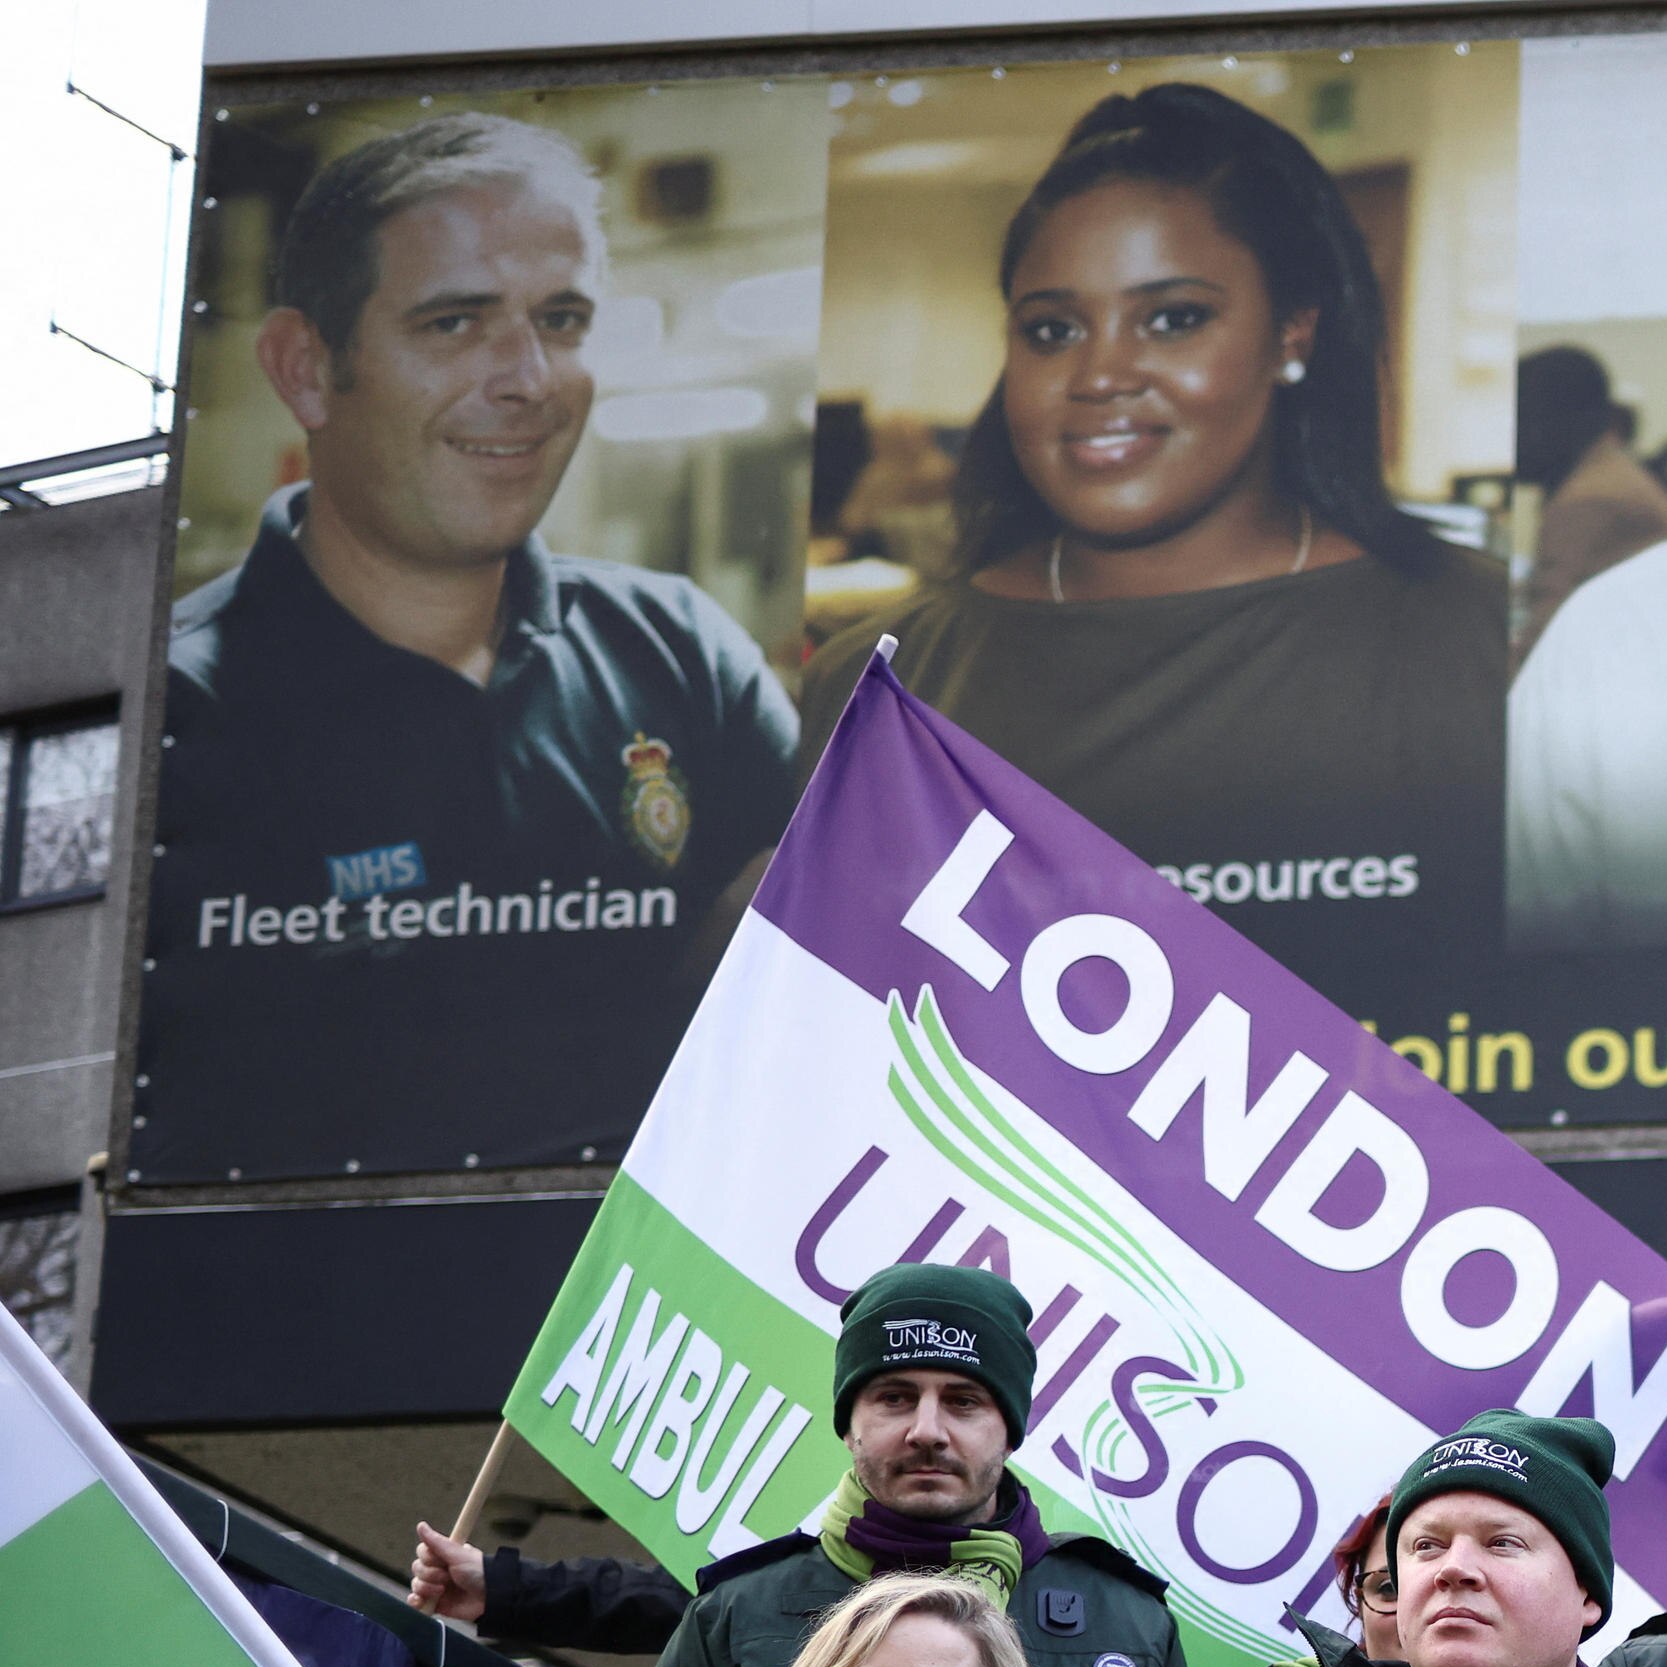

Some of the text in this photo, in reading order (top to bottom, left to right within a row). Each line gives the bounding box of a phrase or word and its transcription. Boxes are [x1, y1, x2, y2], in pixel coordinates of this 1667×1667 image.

[331, 846, 419, 896] NHS
[199, 883, 676, 946] Fleet technician
[882, 1348, 981, 1365] www.lasunison.com
[889, 1324, 978, 1350] UNISON
[540, 1262, 822, 1562] AMBUL
[1432, 1440, 1530, 1468] UNISON
